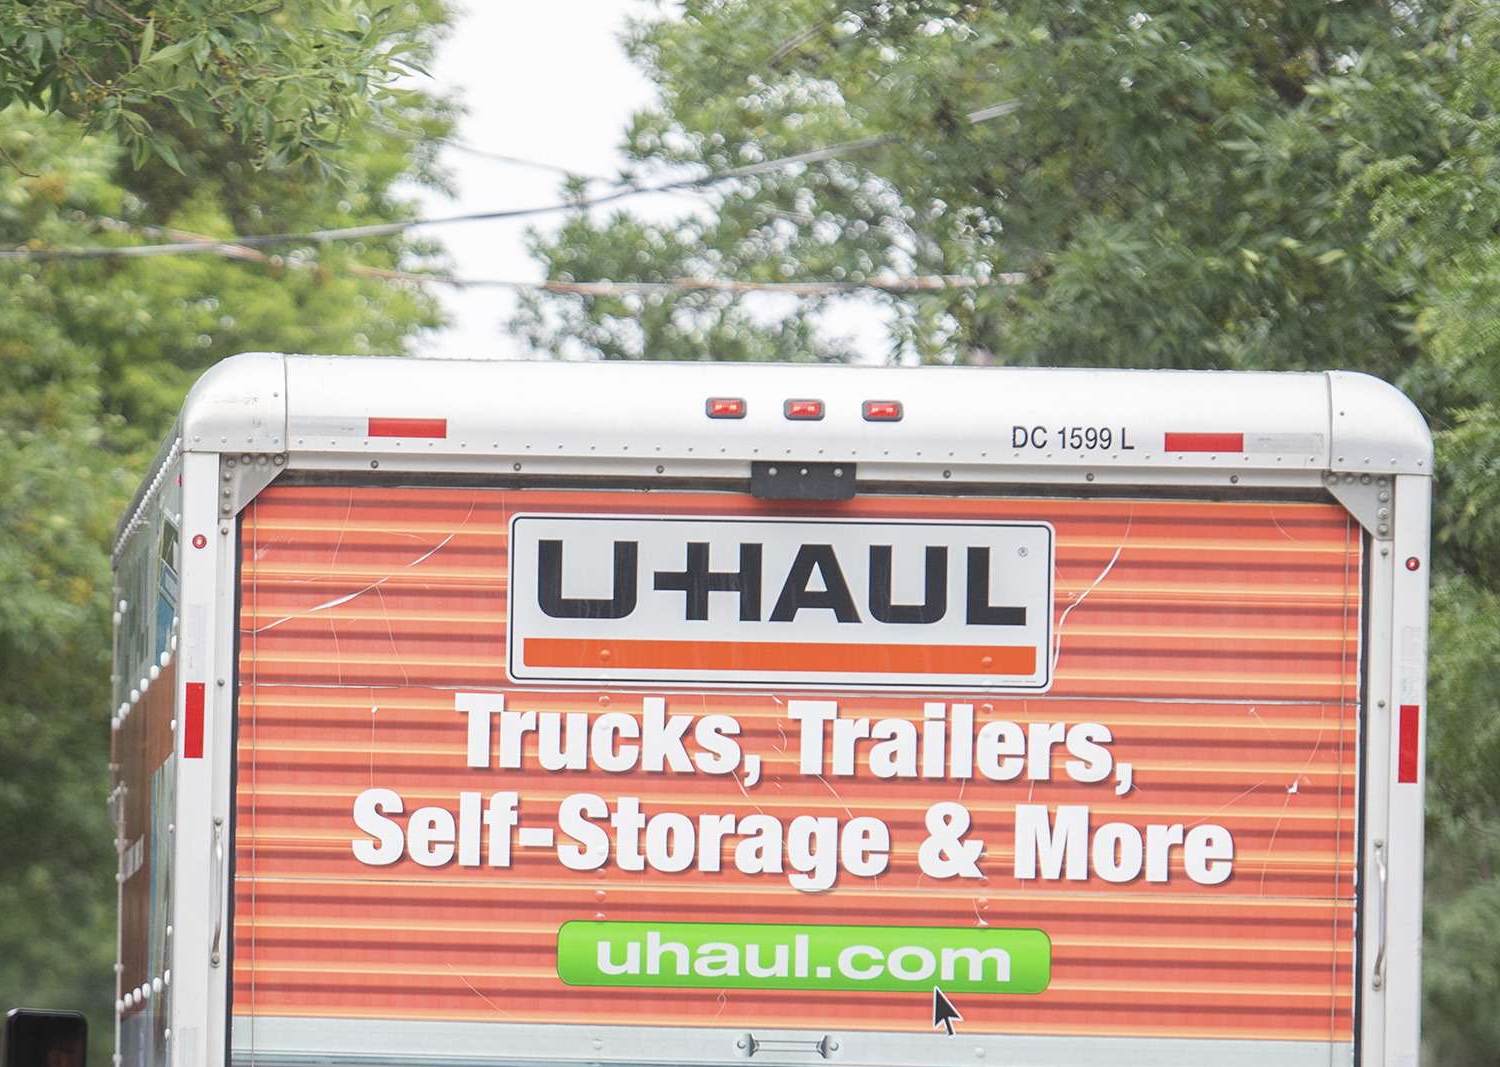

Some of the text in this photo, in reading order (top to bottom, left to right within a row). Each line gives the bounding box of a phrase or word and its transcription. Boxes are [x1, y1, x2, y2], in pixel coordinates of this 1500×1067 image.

[1011, 425, 1135, 450] DC 1599 L
[537, 538, 1027, 627] U-HAUL
[455, 692, 1133, 796] Trucks, Trailers,
[351, 790, 1234, 891] Self-Storage & More
[594, 930, 1011, 982] uhaul.com
